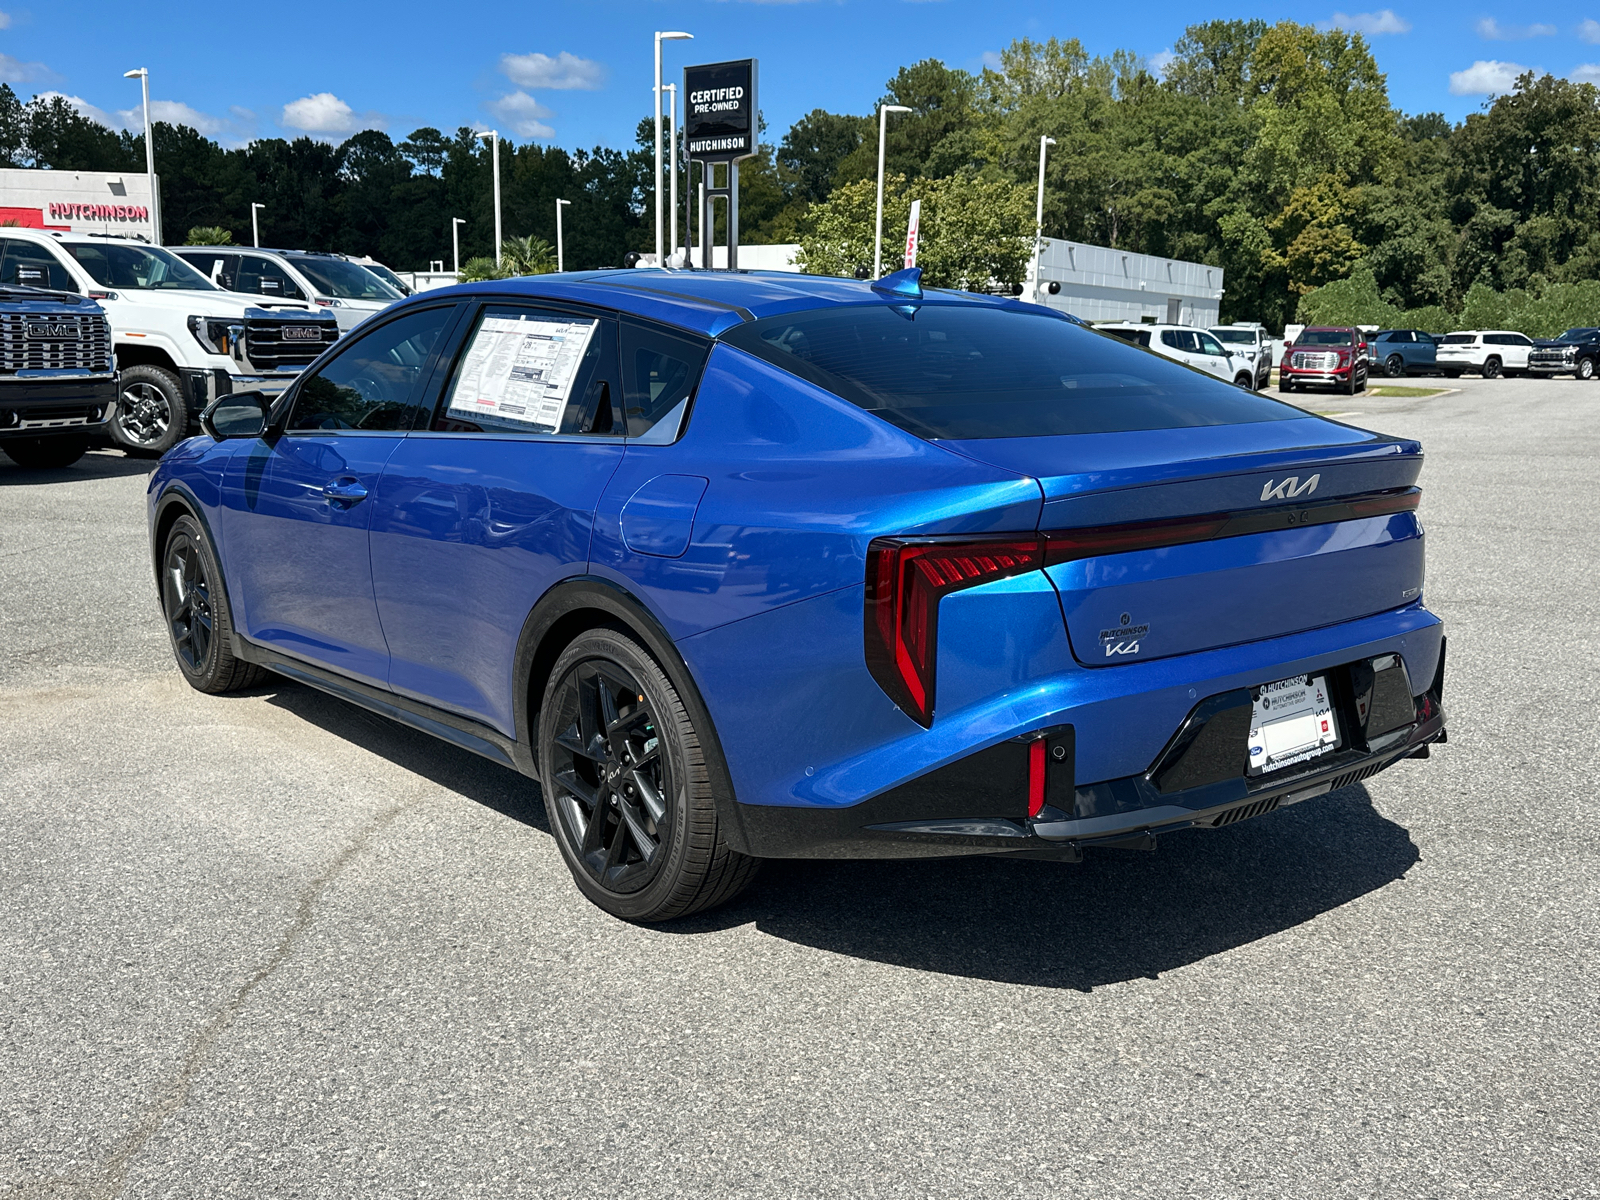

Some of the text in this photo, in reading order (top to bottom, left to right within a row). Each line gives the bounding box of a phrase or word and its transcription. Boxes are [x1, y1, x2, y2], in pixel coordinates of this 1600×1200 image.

[690, 86, 744, 103] CERTIFIED
[694, 100, 739, 113] PRE-OWNED
[690, 137, 745, 152] HUTCHINSON
[49, 202, 148, 220] HUTCHINSON
[28, 323, 79, 337] GMC
[285, 327, 322, 339] GMC
[1260, 473, 1320, 501] KIA
[1100, 625, 1149, 639] HUTCHINSON
[1105, 640, 1140, 657] K4
[1268, 674, 1308, 692] HUTCHINSON
[1271, 689, 1307, 706] HUTCHINSON
[1315, 707, 1330, 717] KIA
[1262, 743, 1334, 774] Hutchinsonautogroup.com
[675, 805, 684, 845] 235/40
